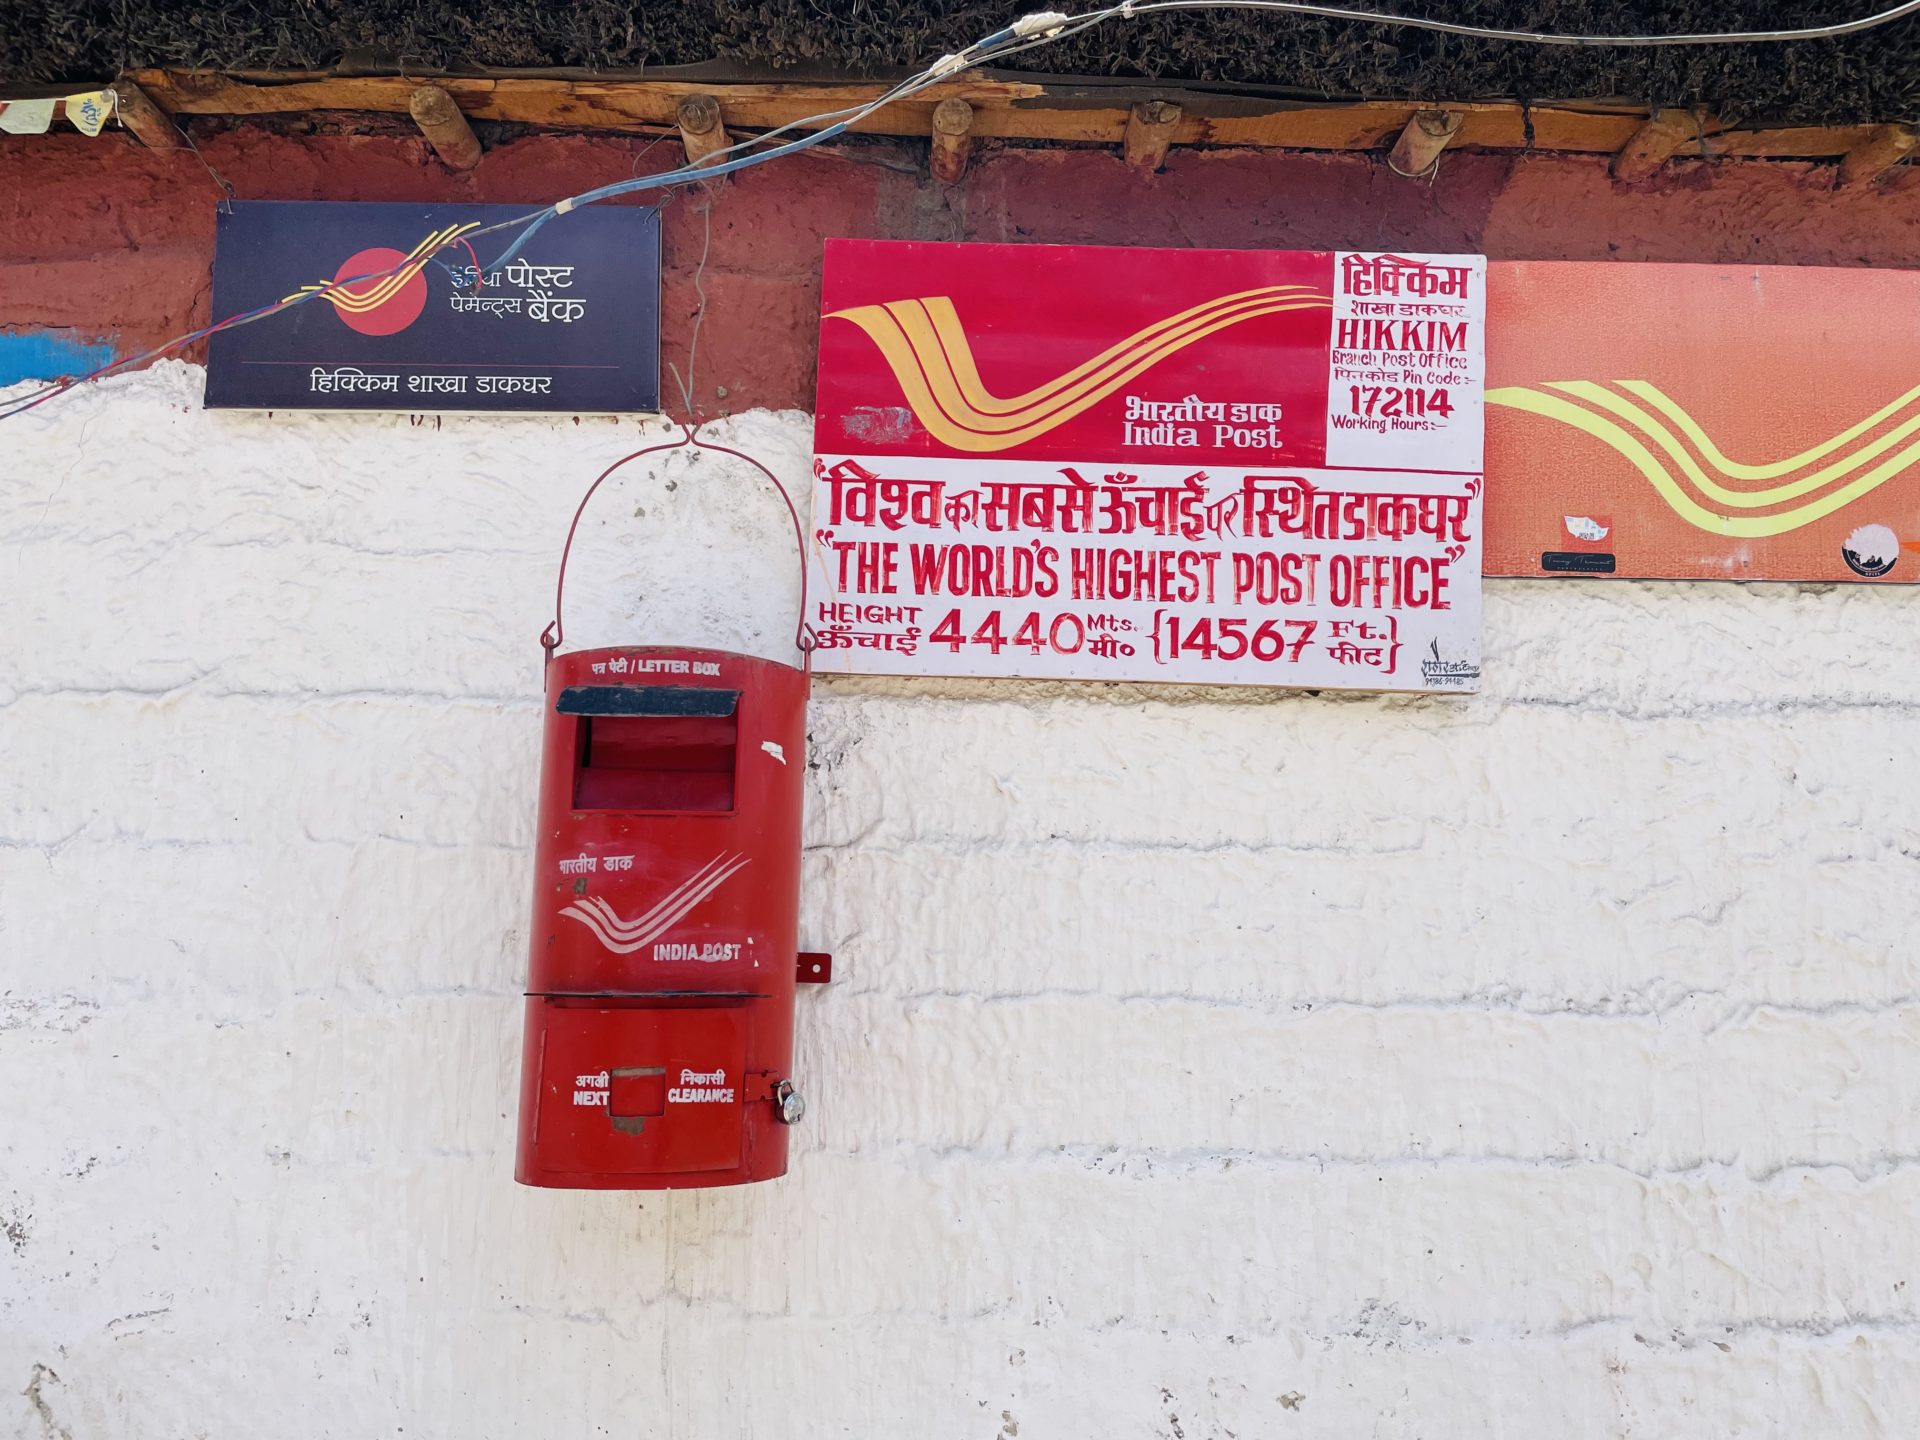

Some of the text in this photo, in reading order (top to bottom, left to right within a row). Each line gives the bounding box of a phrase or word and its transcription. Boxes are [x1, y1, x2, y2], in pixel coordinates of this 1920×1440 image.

[505, 258, 574, 288] पोस्ट
[526, 289, 586, 322] बैंक
[1351, 300, 1470, 318] शाखा डाकघर
[1335, 318, 1469, 352] HIKKIM
[1332, 350, 1468, 369] Branch Post Office
[407, 375, 467, 393] शाखा
[475, 375, 552, 394] डाकघर
[1403, 369, 1423, 385] Pin
[1125, 394, 1282, 423] भारतीय डाक
[1349, 384, 1455, 418] 172114
[1122, 421, 1283, 449] India Post
[1331, 414, 1387, 433] Working
[1070, 548, 1221, 604] HIGHEST
[1232, 551, 1321, 606] POST
[819, 602, 923, 625] HEIGHT
[817, 624, 922, 656] ऊँचाई
[929, 608, 1085, 655] 4440
[591, 662, 607, 675] पत्र
[608, 657, 628, 674] पेटी
[638, 659, 689, 674] LETTER
[692, 661, 720, 676] BOX
[559, 852, 635, 875] भारतीय डाक
[653, 943, 741, 961] INDIA POST
[680, 1068, 726, 1086] निकासी
[573, 1088, 735, 1106] NEXT CLEARANCE
